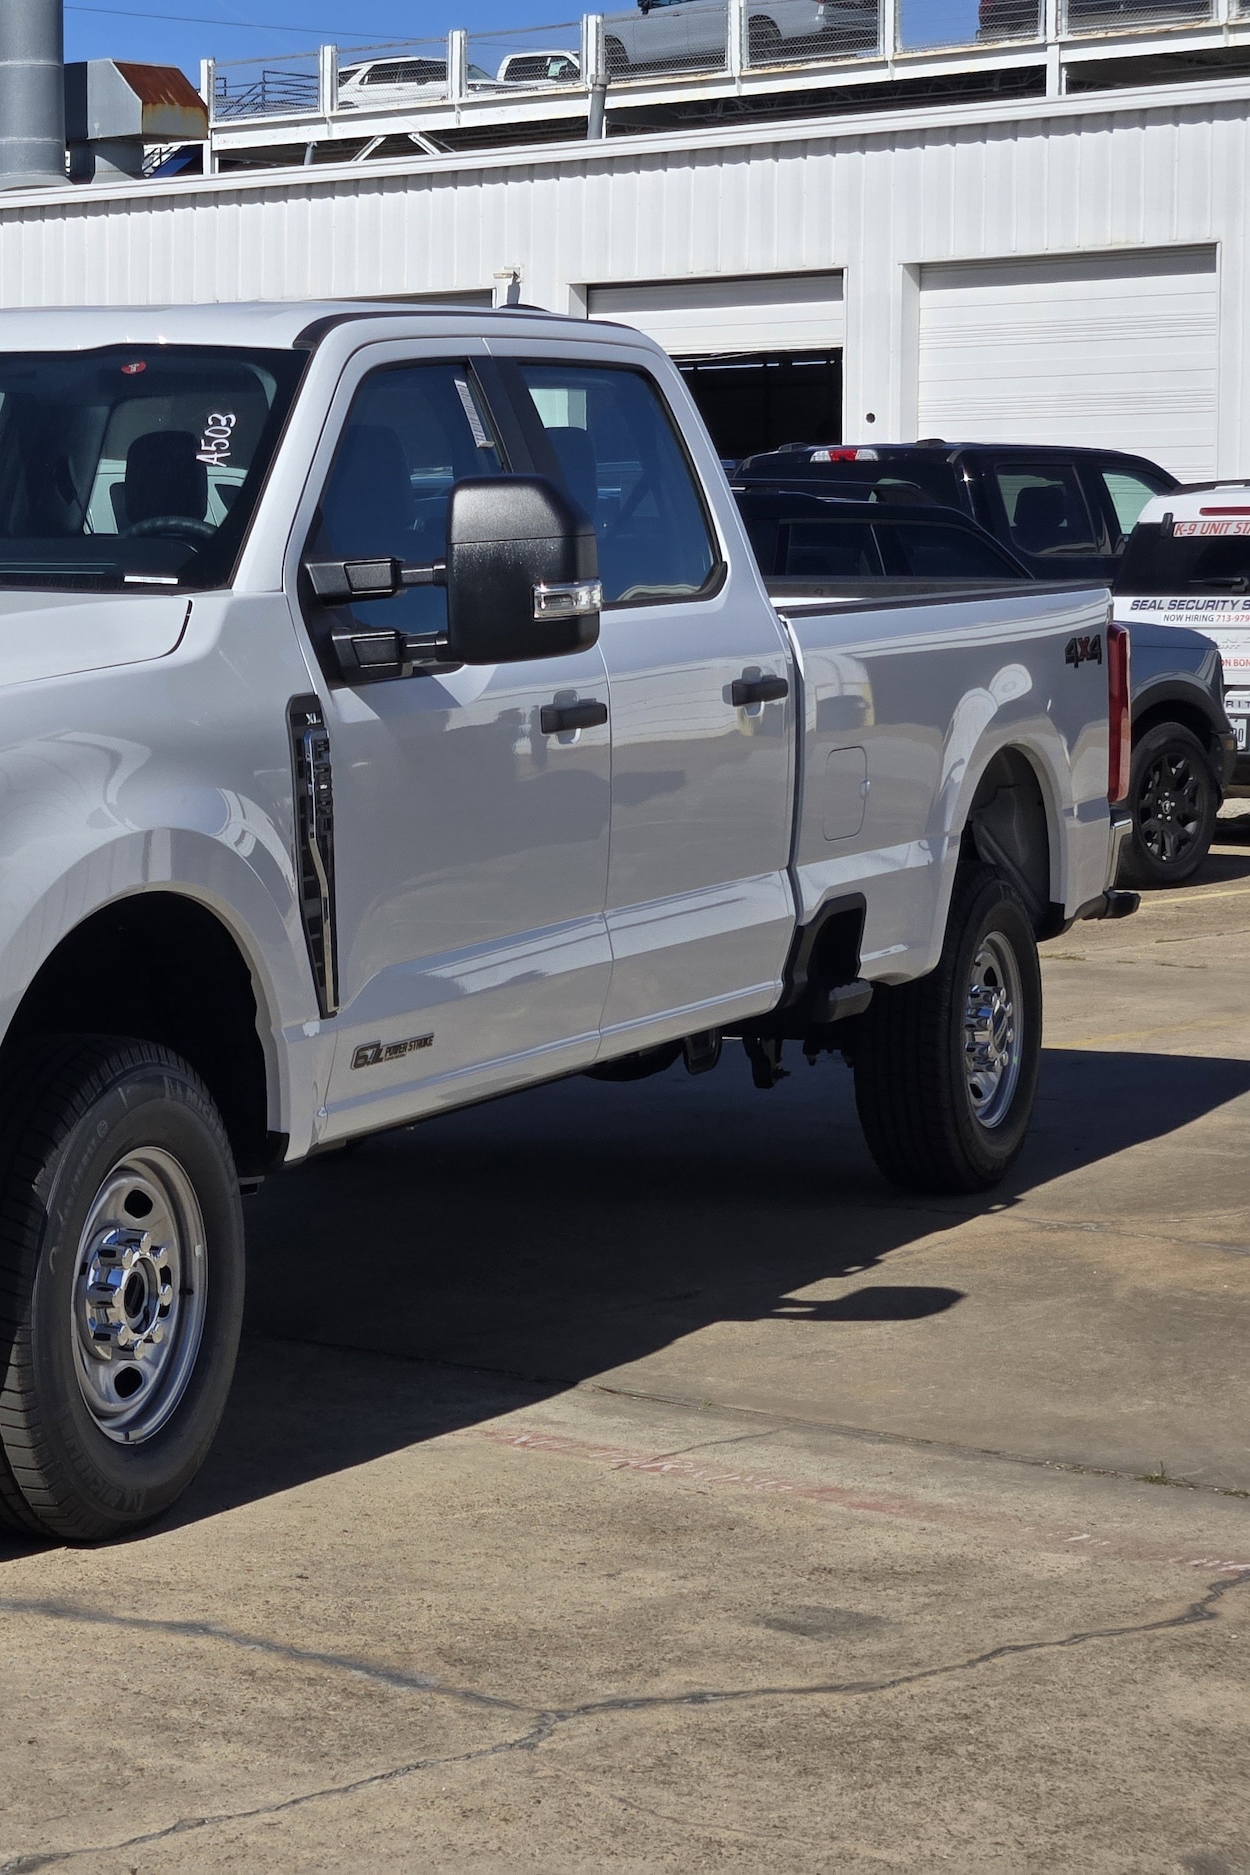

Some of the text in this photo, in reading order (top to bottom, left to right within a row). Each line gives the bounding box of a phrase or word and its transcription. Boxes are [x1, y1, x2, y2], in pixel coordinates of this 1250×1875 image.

[196, 413, 237, 467] A503
[1175, 523, 1198, 535] K-9
[1200, 522, 1233, 534] UNIT
[1130, 599, 1164, 610] SEAL
[1167, 599, 1240, 610] SECURITY
[1163, 614, 1184, 622] NOW
[1185, 614, 1214, 622] HIRING
[306, 713, 321, 725] XL
[385, 1042, 408, 1058] POWER
[408, 1036, 435, 1052] STROKE
